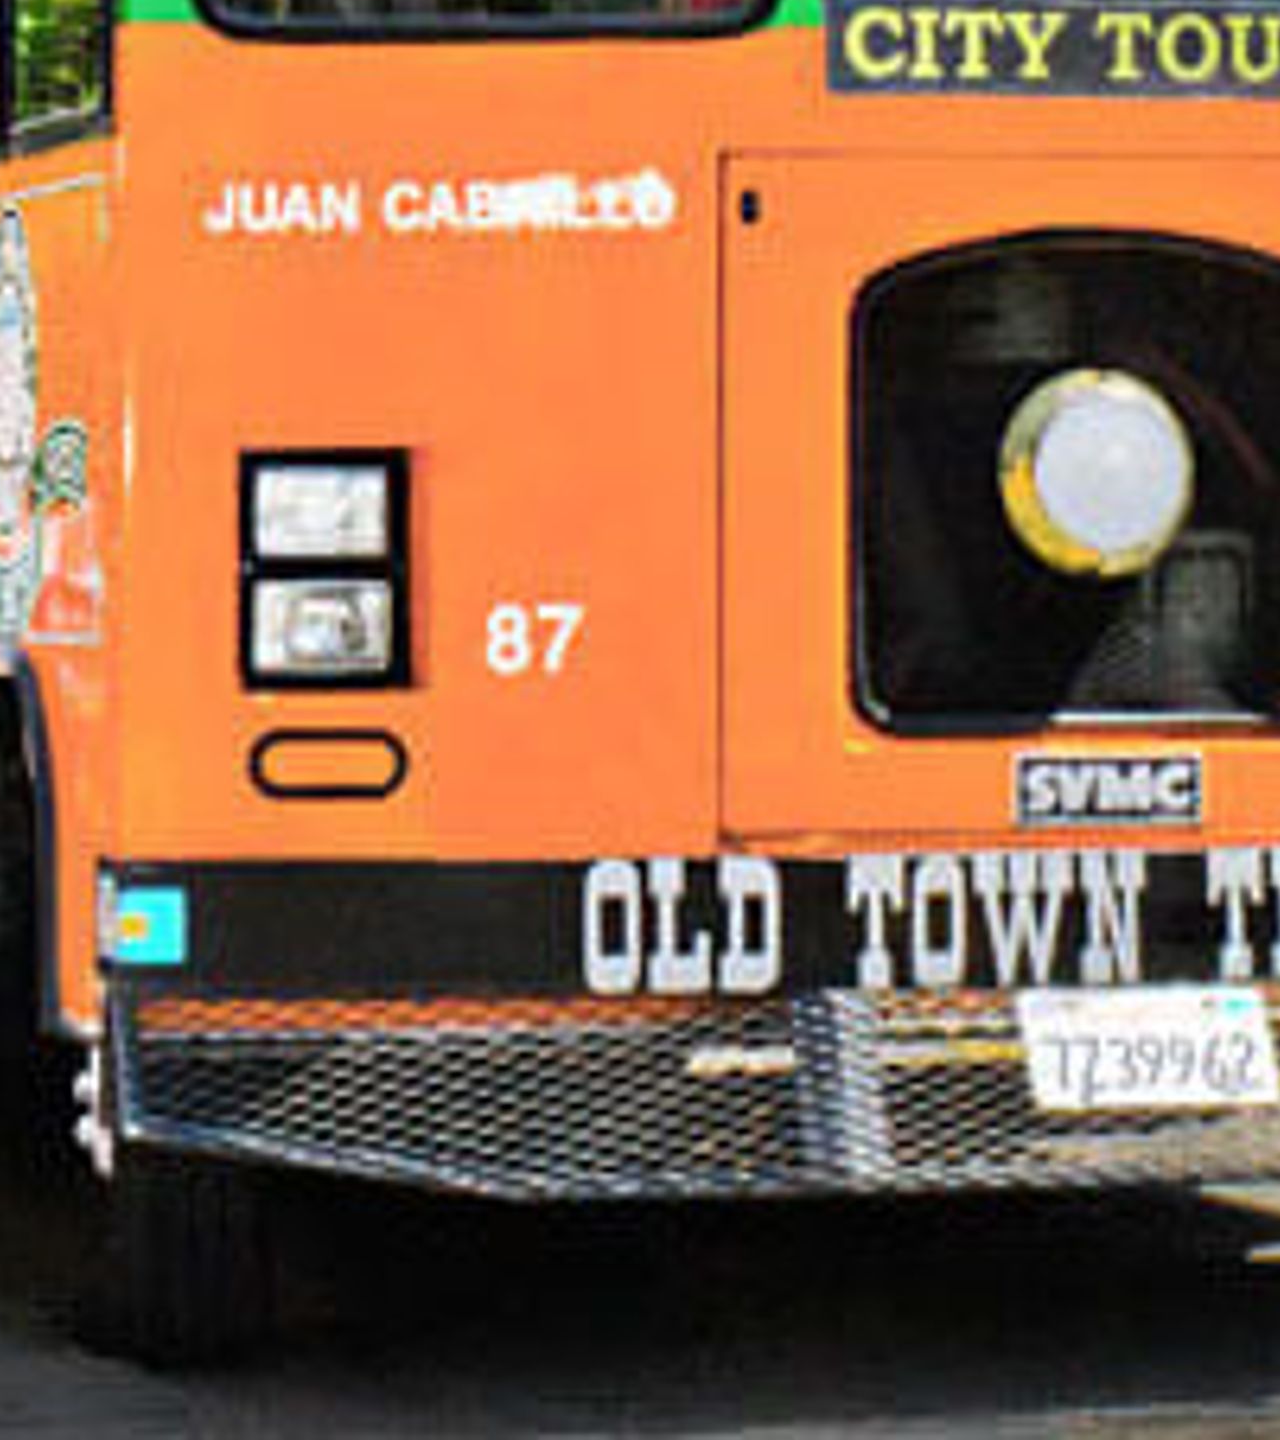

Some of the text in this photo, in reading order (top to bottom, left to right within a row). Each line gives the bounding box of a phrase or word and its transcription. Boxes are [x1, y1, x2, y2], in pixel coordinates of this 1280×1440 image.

[844, 6, 1067, 81] CITY
[204, 178, 360, 232] JUAN
[487, 602, 582, 674] 87
[1027, 763, 1194, 811] SVMC
[583, 856, 782, 995] OLD
[846, 852, 1146, 988] TOWN
